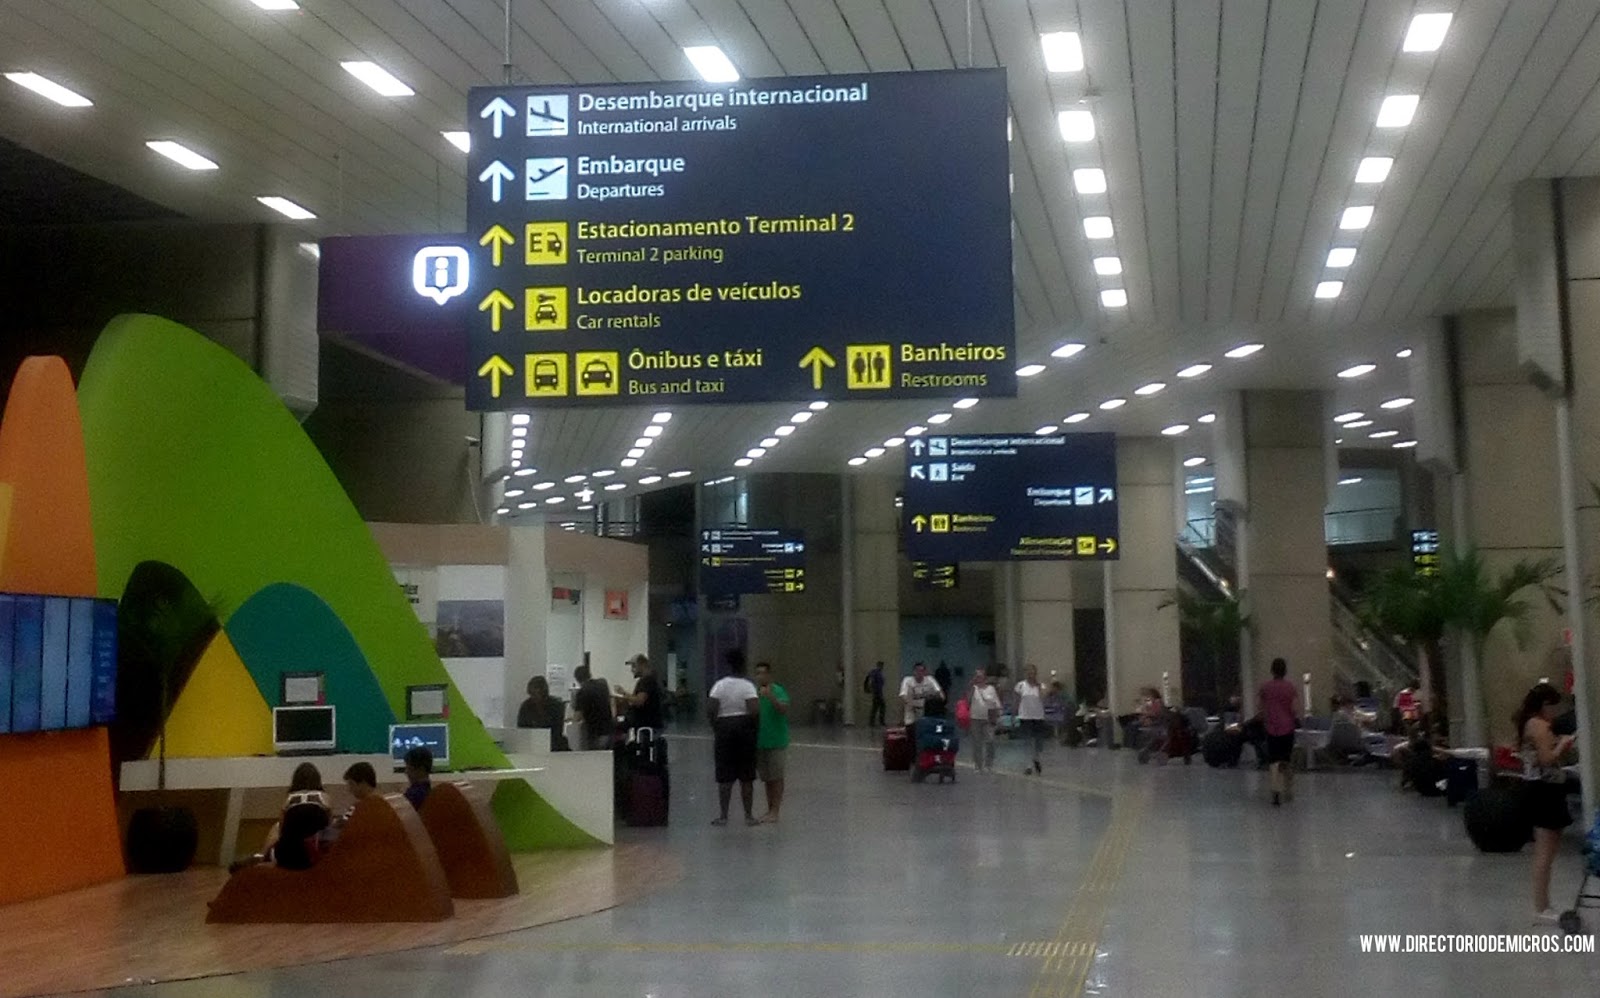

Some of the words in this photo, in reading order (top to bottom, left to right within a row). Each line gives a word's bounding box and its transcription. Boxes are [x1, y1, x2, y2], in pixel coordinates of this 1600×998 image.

[578, 92, 724, 114] Desembarque
[728, 82, 868, 107] internacional
[577, 117, 678, 136] International
[681, 115, 737, 132] arrivals
[577, 154, 686, 178] Embarque
[577, 183, 665, 203] Departures
[577, 219, 741, 240] Estacionamento
[745, 213, 837, 235] Terminal
[842, 213, 854, 231] 2
[577, 246, 645, 264] Terminal
[649, 247, 659, 262] 2
[663, 245, 724, 266] parking
[577, 284, 681, 306] Locadoras
[686, 283, 712, 302] de
[717, 281, 801, 301] veículos
[576, 314, 604, 330] Car
[607, 312, 661, 329] rentals
[628, 348, 702, 370] Ônibus
[707, 354, 719, 368] e
[724, 348, 762, 368] táxi
[901, 342, 1006, 363] Banheiros
[628, 379, 657, 395] Bus
[660, 378, 691, 394] and
[695, 378, 724, 393] taxi
[901, 372, 987, 389] Restrooms
